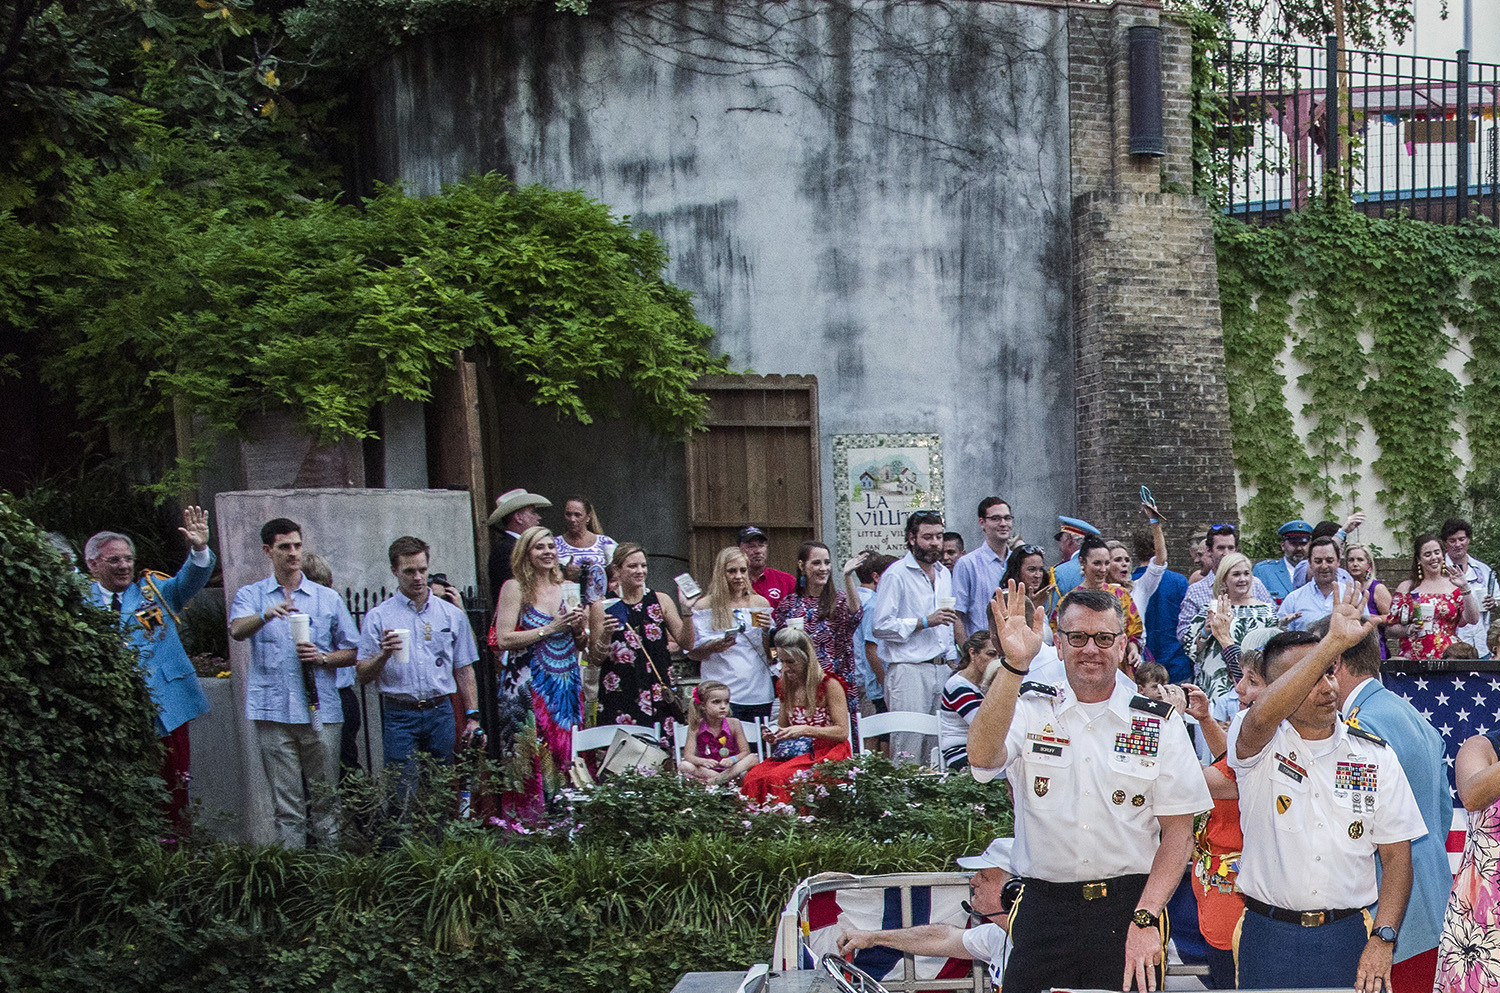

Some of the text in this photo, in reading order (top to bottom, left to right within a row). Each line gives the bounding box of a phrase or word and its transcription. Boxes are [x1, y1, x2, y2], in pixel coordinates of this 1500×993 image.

[866, 494, 889, 509] LA
[856, 510, 910, 526] VILLIT
[881, 534, 889, 545] of
